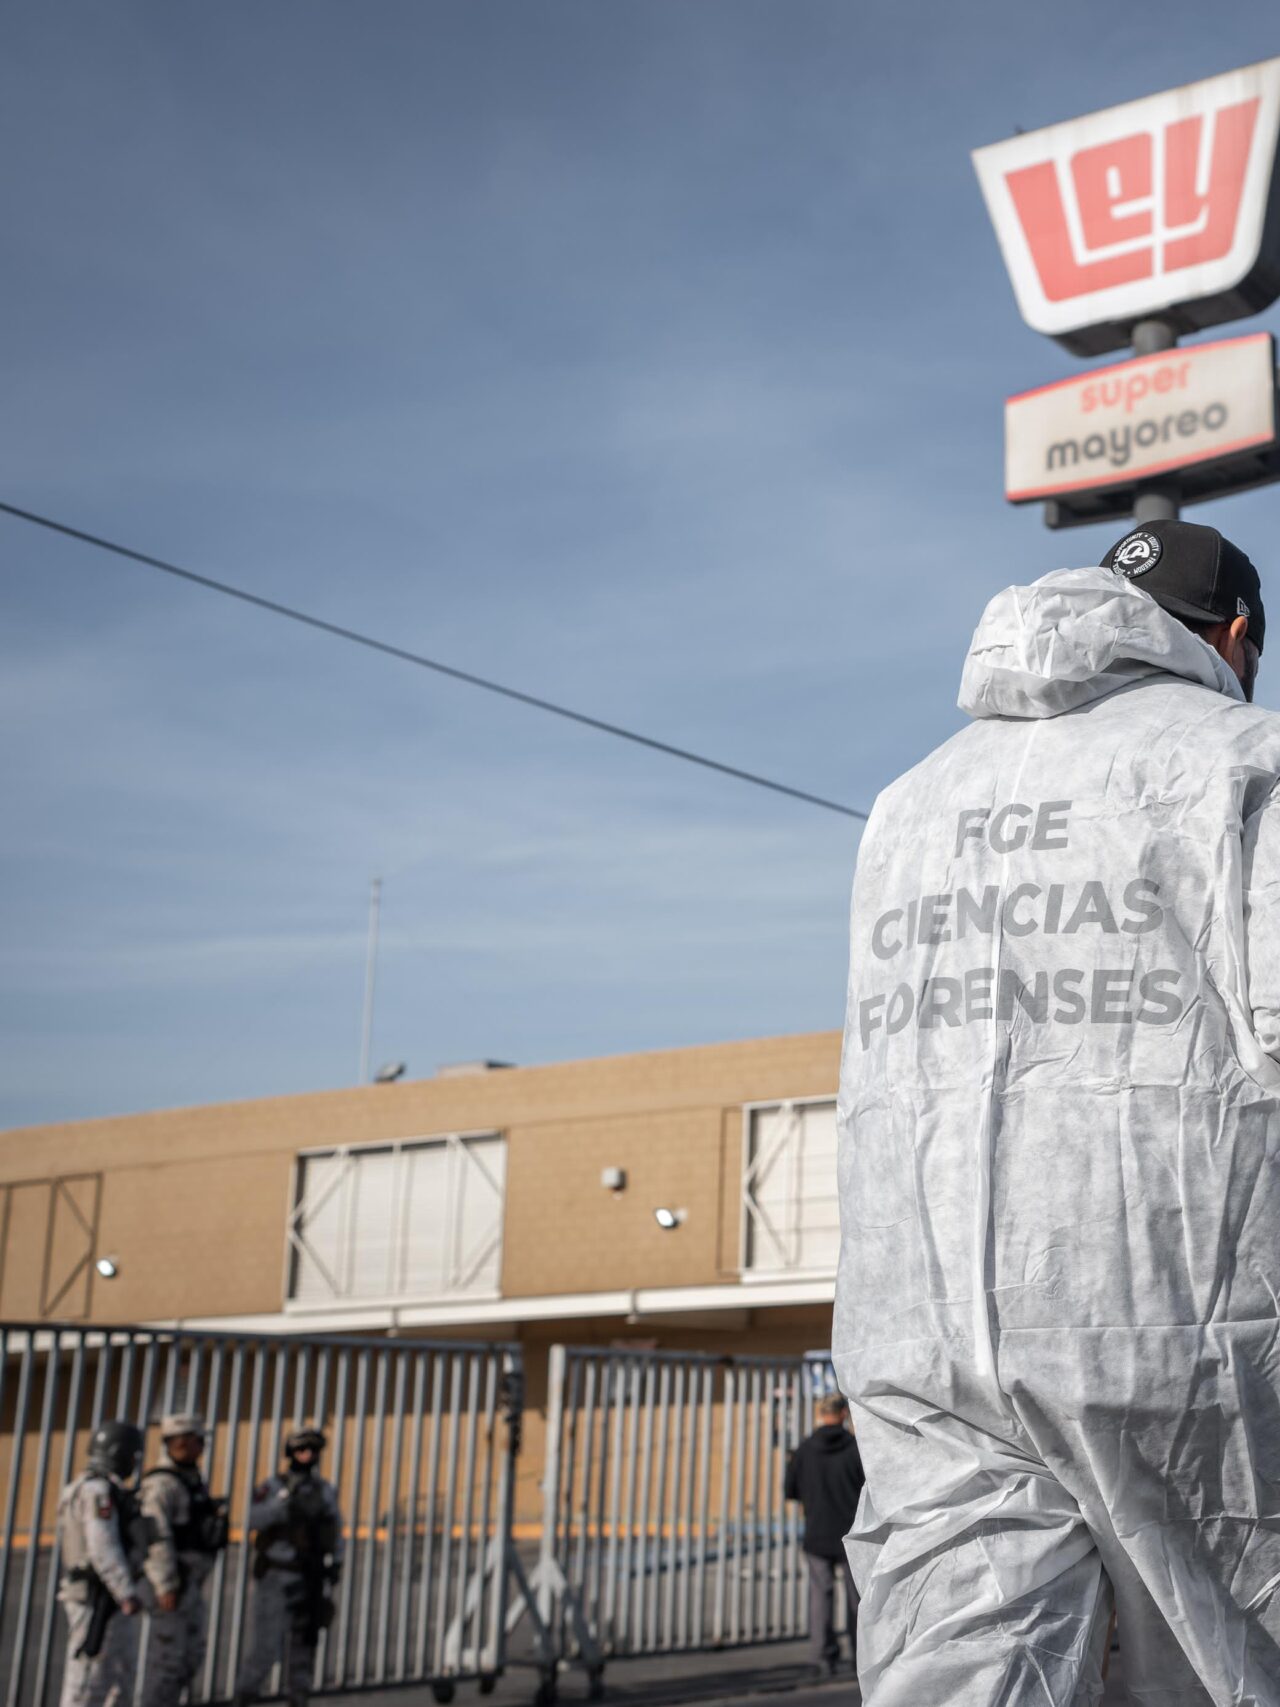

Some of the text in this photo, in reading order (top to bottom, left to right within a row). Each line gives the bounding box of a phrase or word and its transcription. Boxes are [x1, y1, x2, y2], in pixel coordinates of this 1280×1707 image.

[1080, 360, 1193, 413] super
[1045, 402, 1230, 470] mayoreo
[954, 800, 1072, 858] FGE
[871, 878, 1164, 960] CIENCIAS
[859, 967, 1183, 1051] FORENSES
